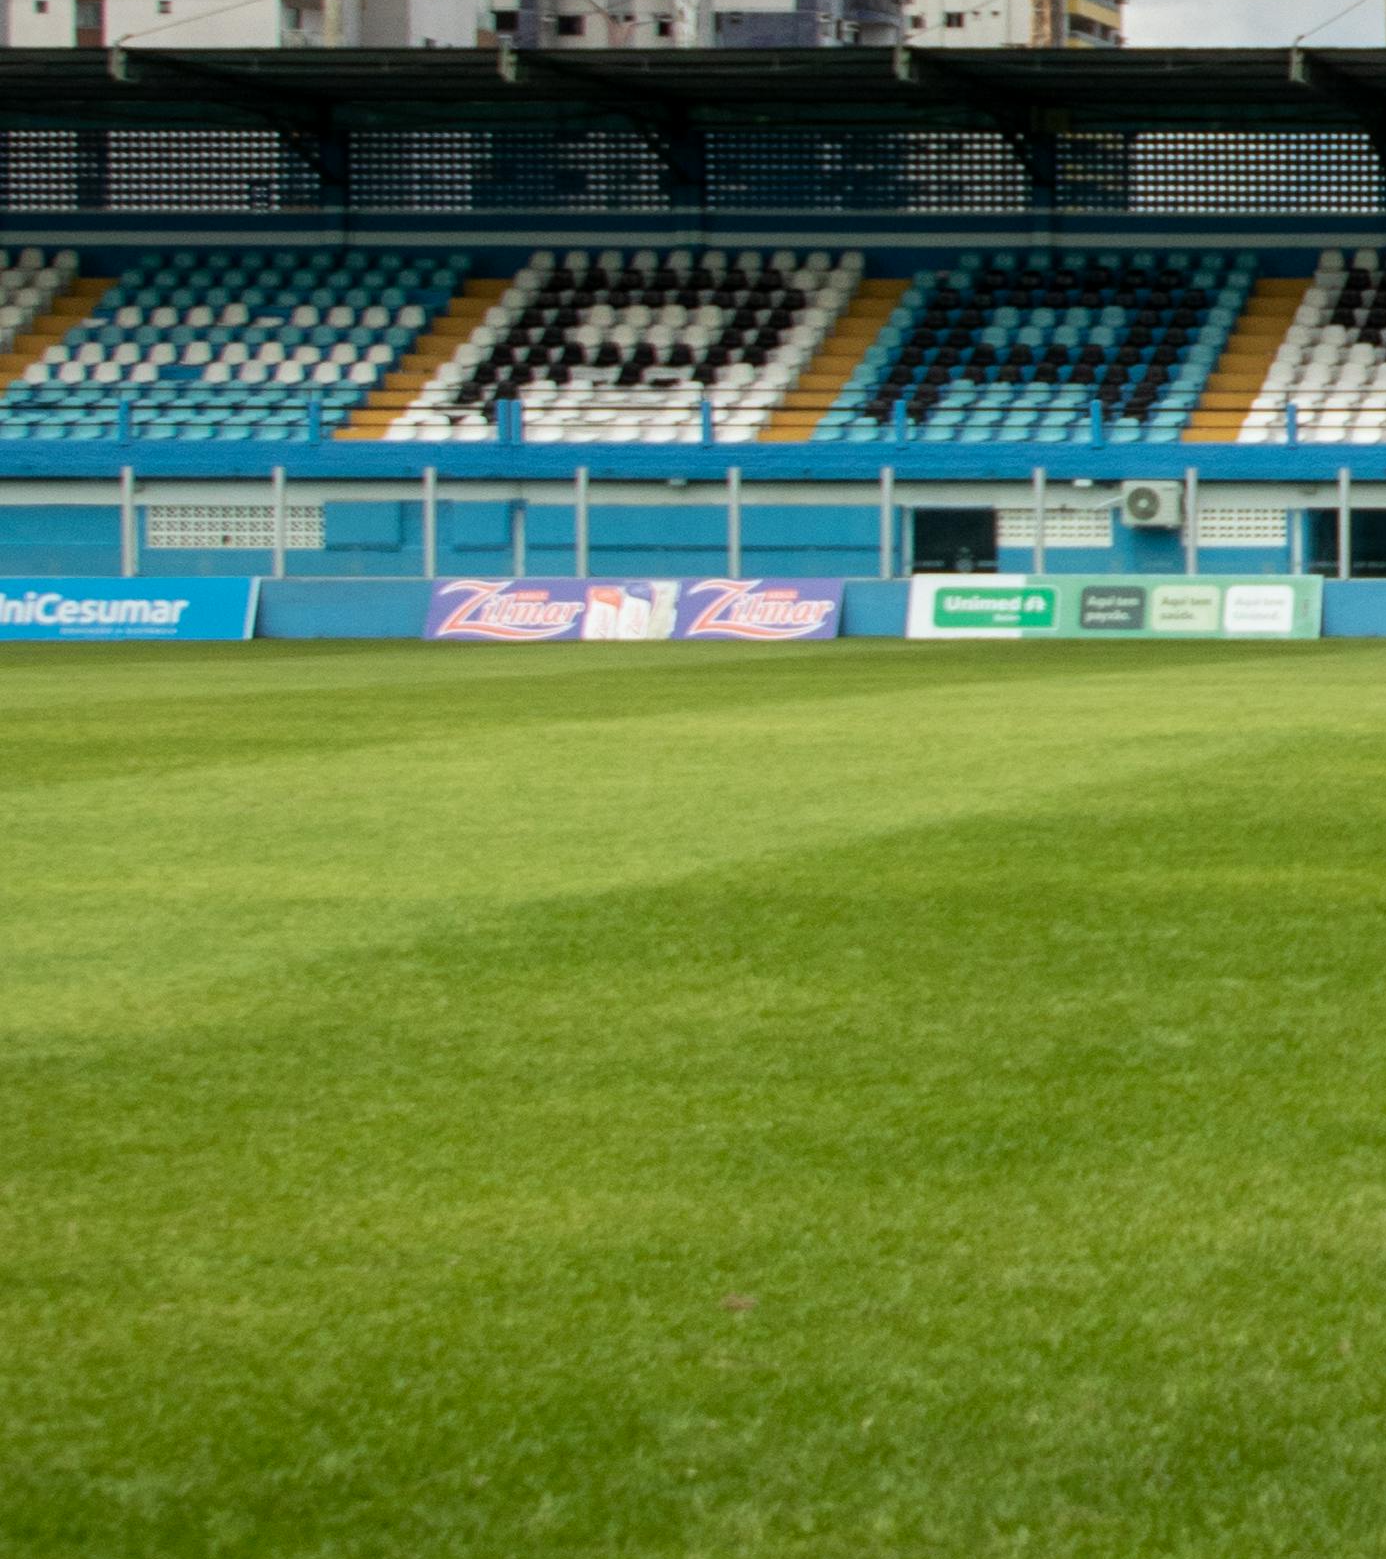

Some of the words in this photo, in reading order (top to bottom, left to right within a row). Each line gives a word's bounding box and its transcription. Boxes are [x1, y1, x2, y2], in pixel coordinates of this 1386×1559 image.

[436, 580, 586, 639] Zilmar
[686, 579, 836, 639] Zilmar
[943, 595, 1022, 612] Unimed
